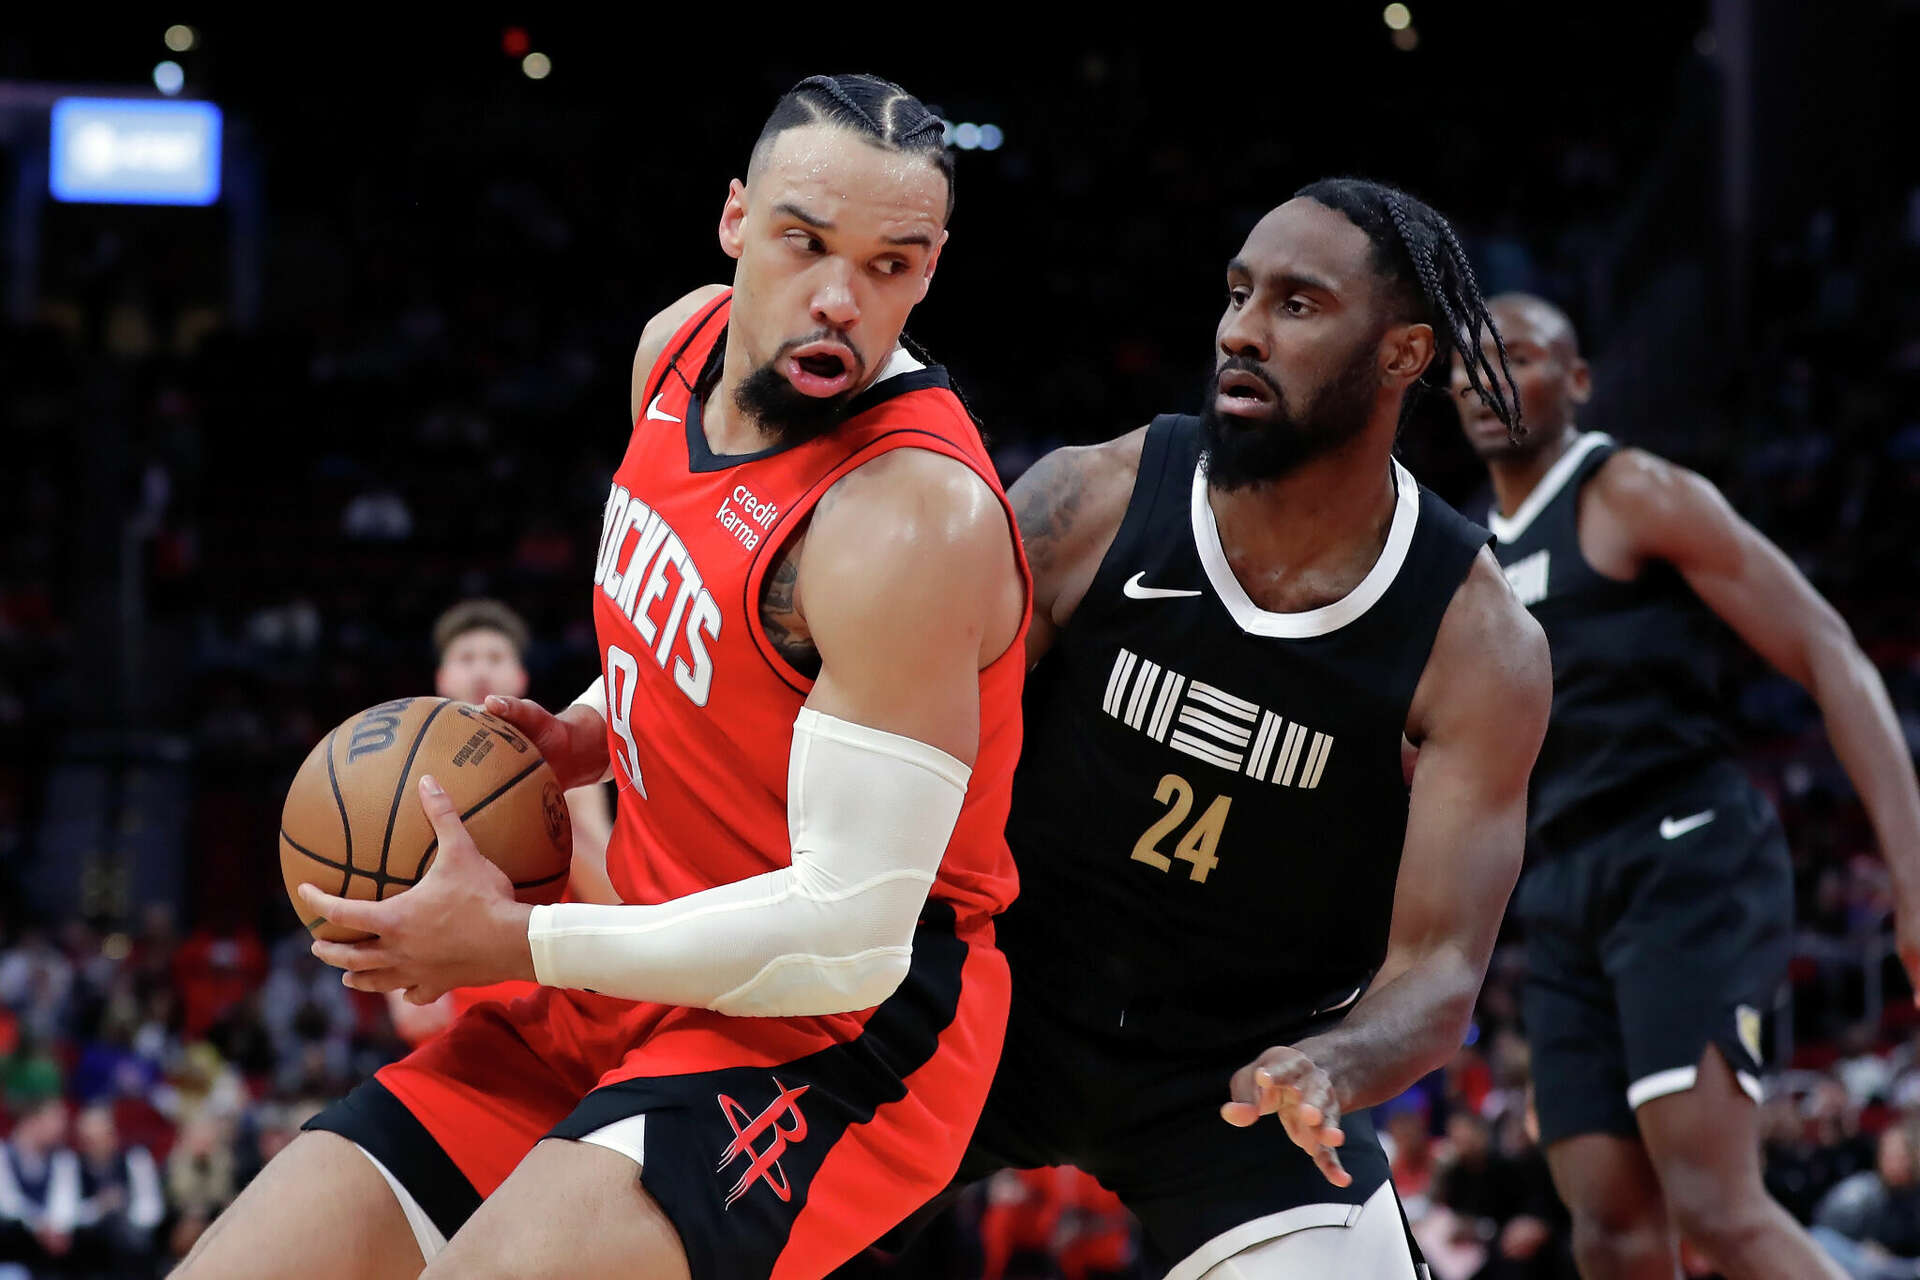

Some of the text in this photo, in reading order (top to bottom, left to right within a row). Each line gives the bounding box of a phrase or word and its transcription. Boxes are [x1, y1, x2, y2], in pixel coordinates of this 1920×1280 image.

[715, 496, 760, 552] karma
[732, 485, 779, 531] credit
[607, 645, 648, 800] 9
[1130, 773, 1233, 884] 24
